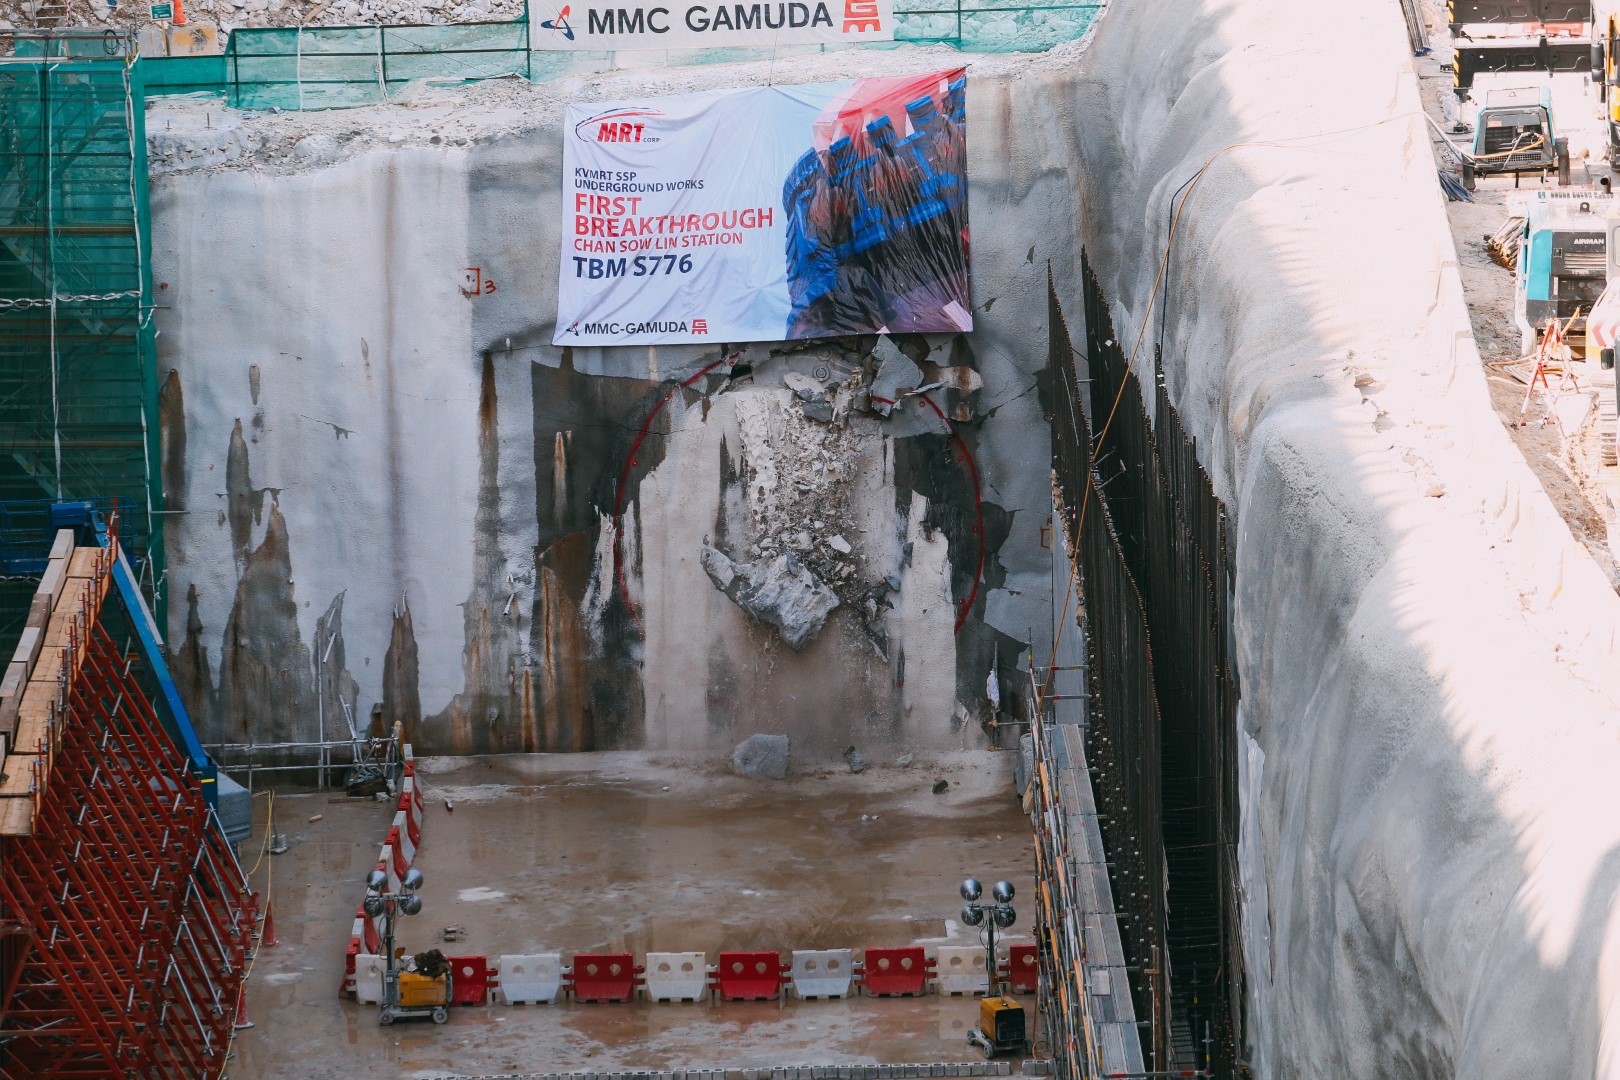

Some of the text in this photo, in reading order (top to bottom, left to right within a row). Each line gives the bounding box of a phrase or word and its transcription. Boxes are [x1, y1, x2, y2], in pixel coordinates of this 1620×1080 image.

[588, 2, 833, 34] MMC GAMUDA
[597, 122, 645, 142] MRT
[575, 167, 637, 181] KVMRT SSP
[574, 178, 704, 192] UNDERGROUND WORKS
[575, 193, 642, 216] FIRST
[575, 207, 773, 237] BREAKTHROUGH
[574, 232, 743, 253] CHAN SOW LIN STATION
[573, 253, 693, 279] TBM S776
[485, 280, 497, 295] 3
[584, 321, 688, 334] MMC-GAMUDA
